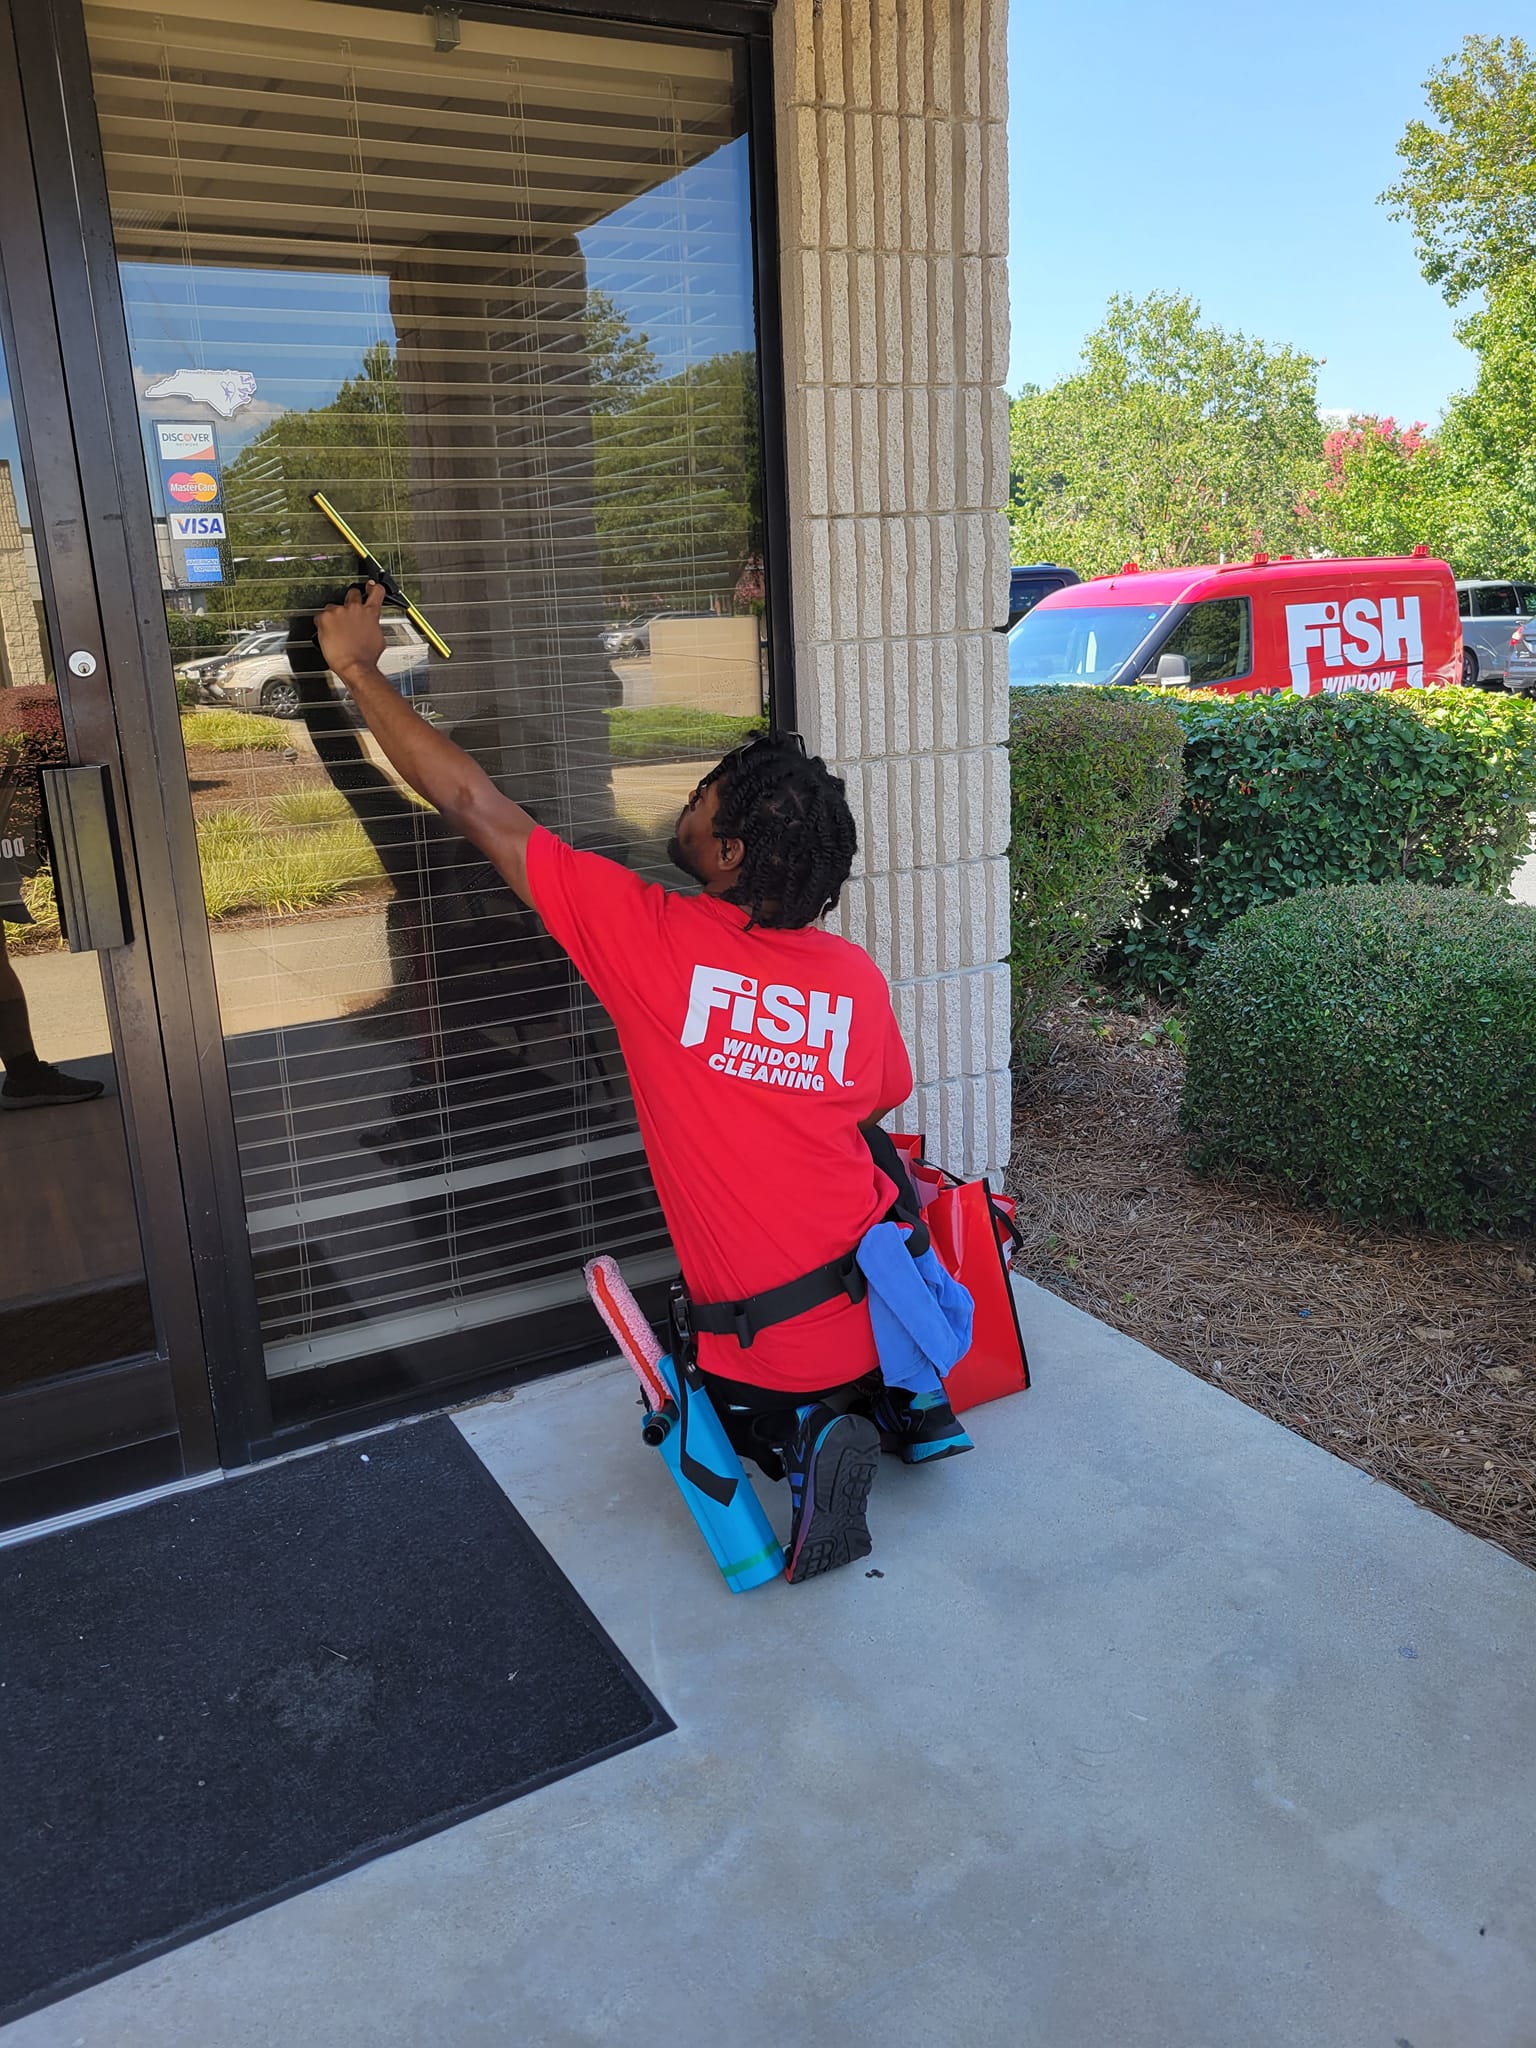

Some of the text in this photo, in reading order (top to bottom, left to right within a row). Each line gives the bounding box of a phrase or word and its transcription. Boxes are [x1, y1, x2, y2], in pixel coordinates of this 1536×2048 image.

[161, 432, 210, 442] DISCOVER
[170, 482, 216, 492] MasterCard
[176, 518, 223, 534] VISA
[1322, 671, 1396, 694] WINDOW
[723, 1037, 819, 1072] WINDOW
[708, 1053, 825, 1092] CLEANING
